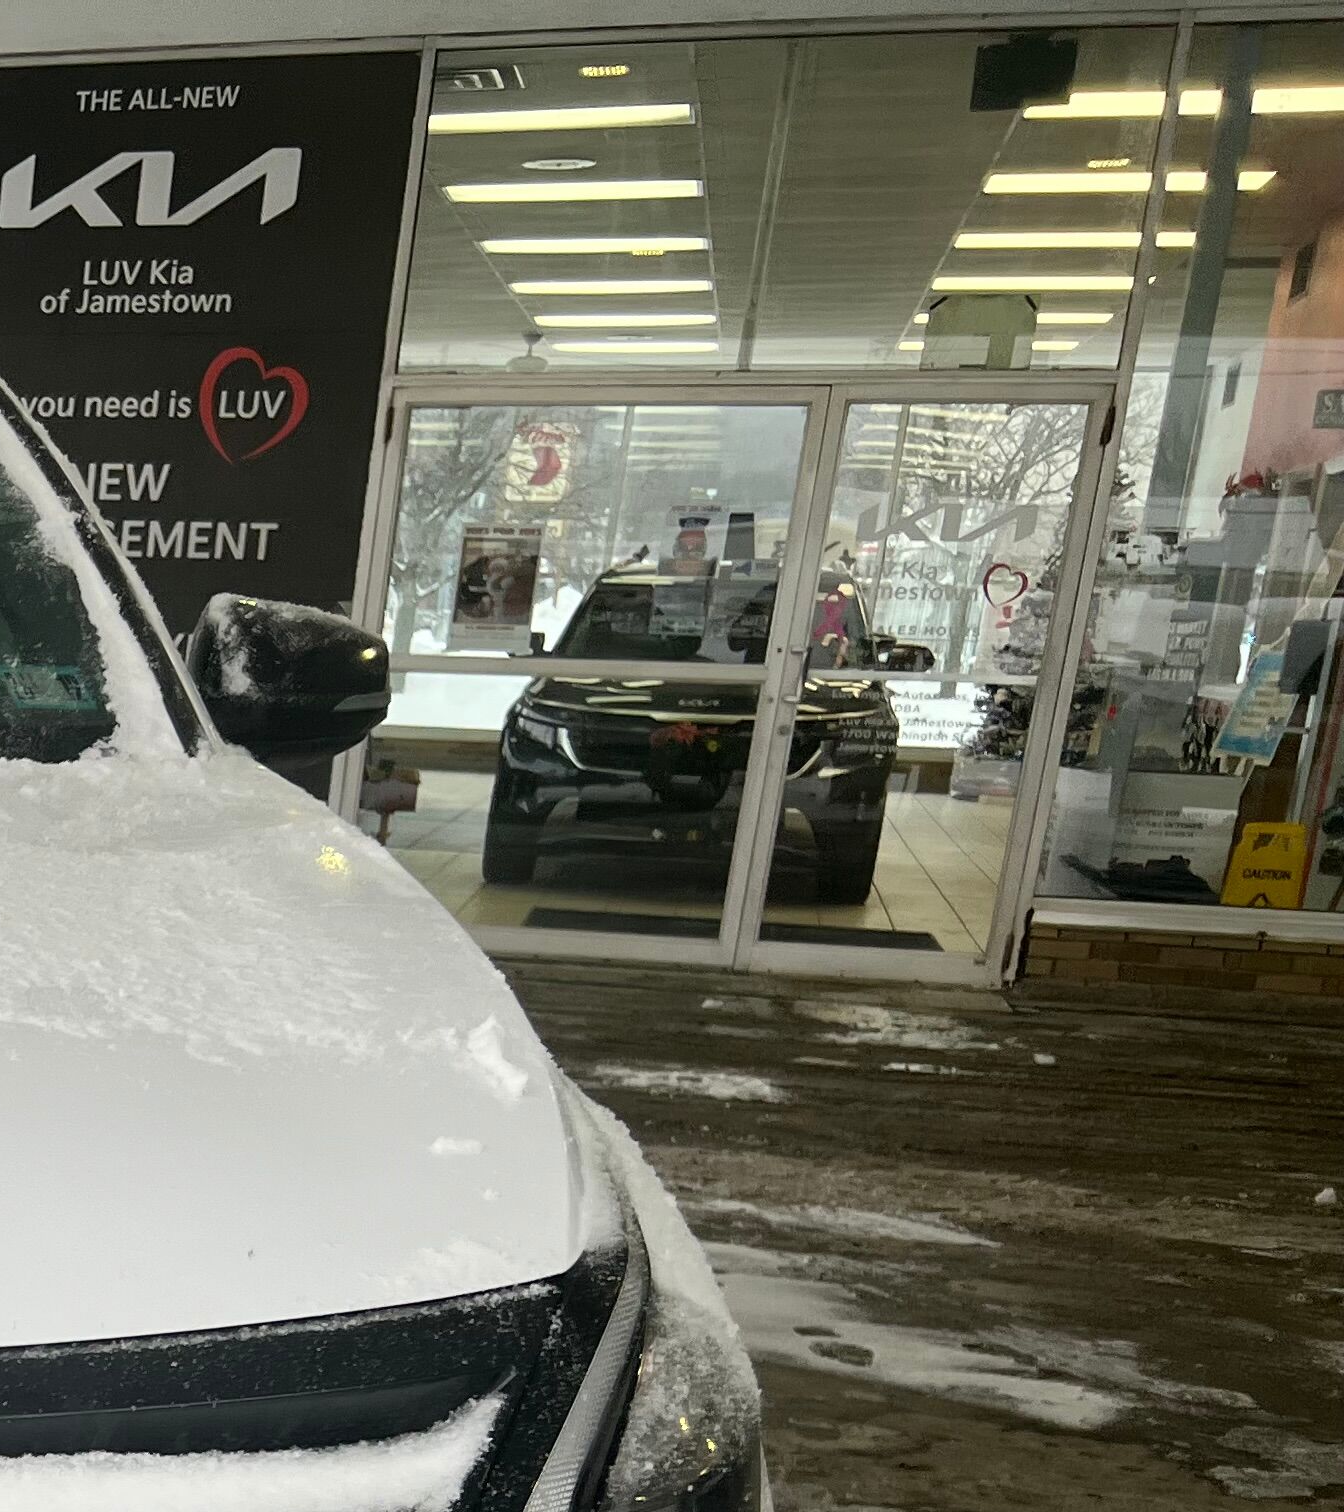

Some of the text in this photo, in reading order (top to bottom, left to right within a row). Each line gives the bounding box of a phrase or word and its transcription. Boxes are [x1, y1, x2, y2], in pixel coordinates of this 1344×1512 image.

[76, 85, 241, 112] THE ALL-NEW
[83, 259, 194, 286] LUV Kia
[40, 288, 232, 314] of Jamestown
[84, 390, 160, 418] need
[168, 389, 192, 418] is
[218, 390, 287, 419] LUV
